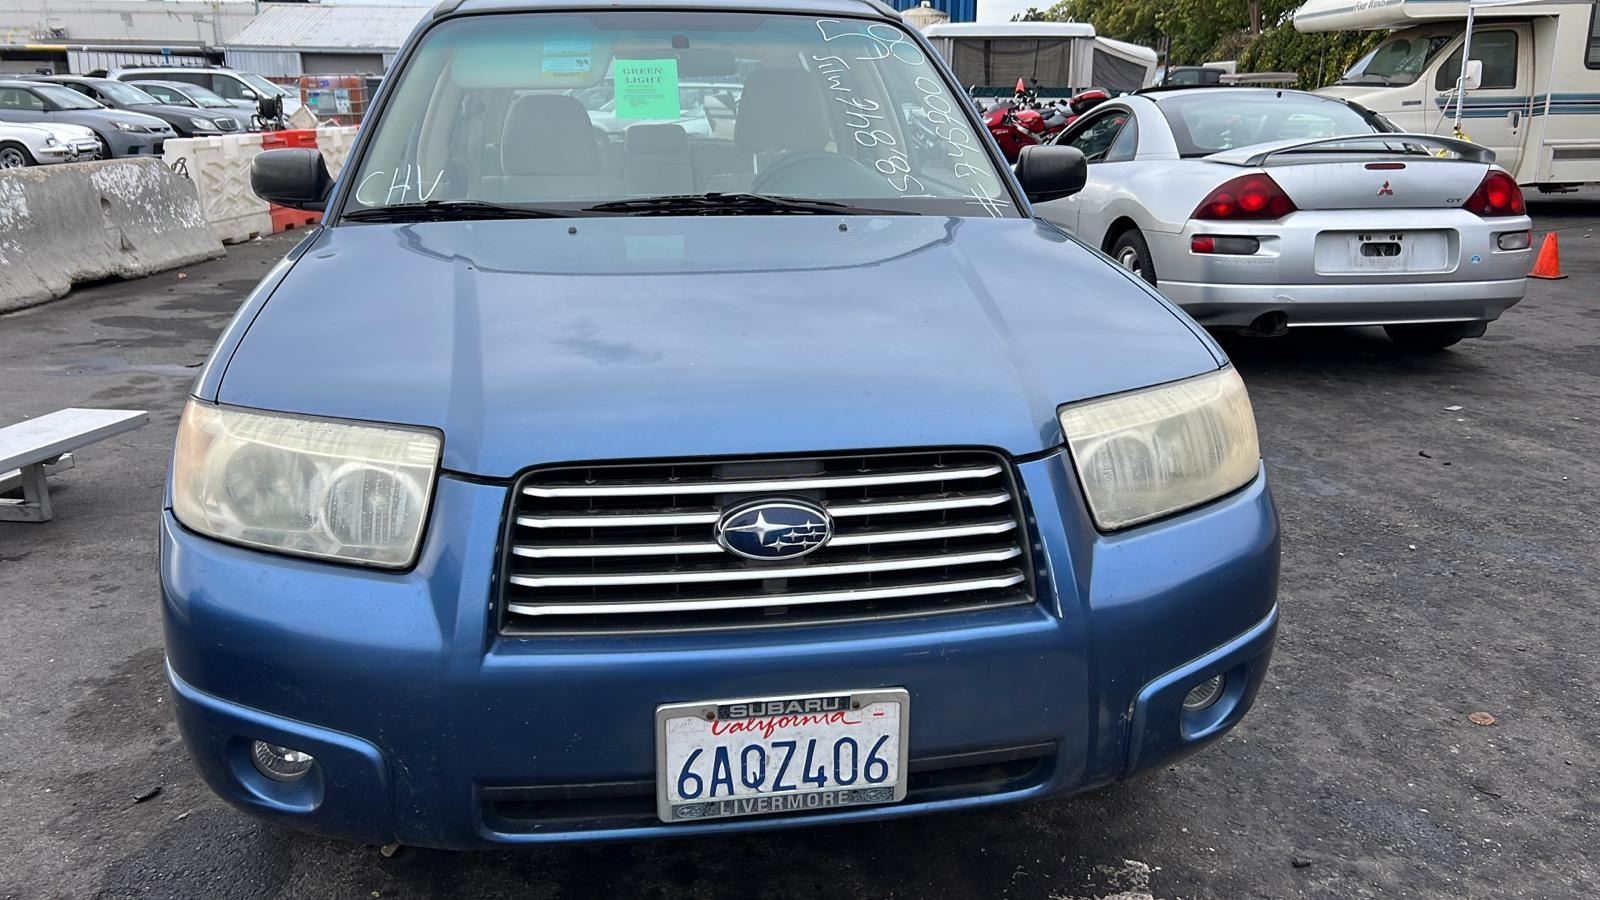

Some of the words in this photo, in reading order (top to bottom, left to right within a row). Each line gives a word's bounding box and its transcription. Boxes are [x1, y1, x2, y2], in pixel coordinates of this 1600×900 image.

[622, 67, 663, 75] GREEN
[626, 76, 663, 84] LIGHT
[355, 163, 445, 206] CHV
[729, 697, 840, 718] SUBARU
[711, 710, 862, 739] California
[677, 735, 890, 799] 6AQZ406
[720, 790, 849, 816] LIVERMORE
